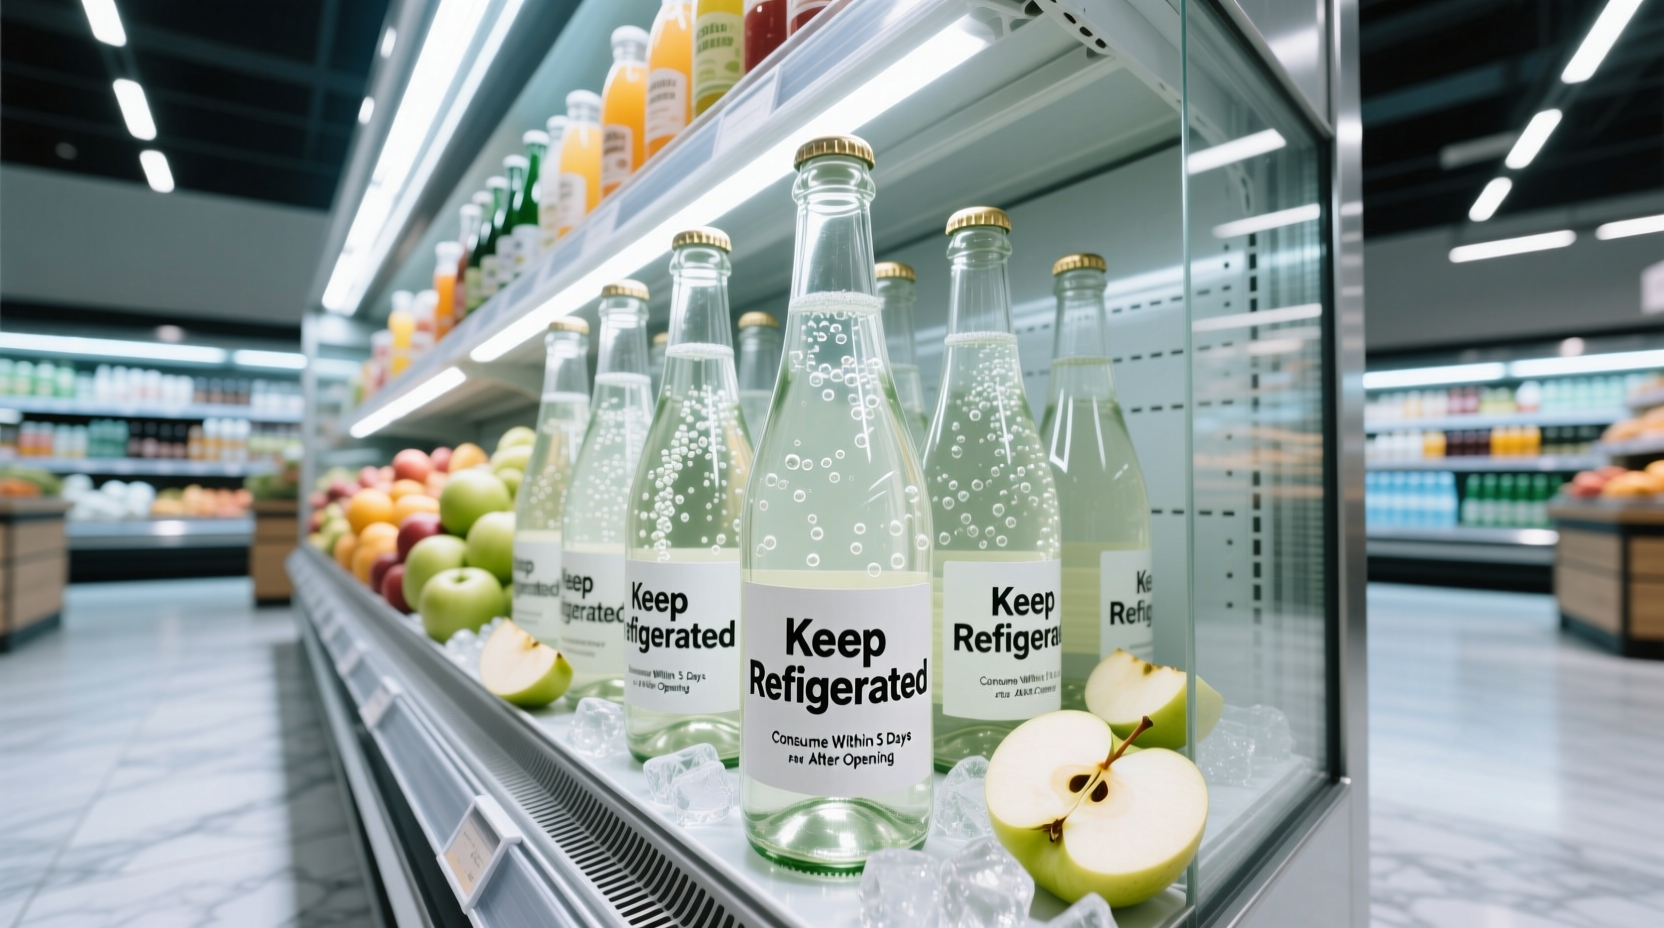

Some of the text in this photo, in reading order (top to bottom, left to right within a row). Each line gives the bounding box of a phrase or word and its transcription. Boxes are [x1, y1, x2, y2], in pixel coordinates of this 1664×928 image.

[632, 581, 688, 622] Keep
[991, 586, 1055, 620] Keep
[786, 617, 887, 668] Keep
[749, 657, 928, 715] Refigerated
[771, 730, 829, 749] Consume
[876, 732, 884, 746] 5
[886, 731, 912, 748] Days
[808, 751, 840, 766] After
[843, 751, 895, 770] Opening
